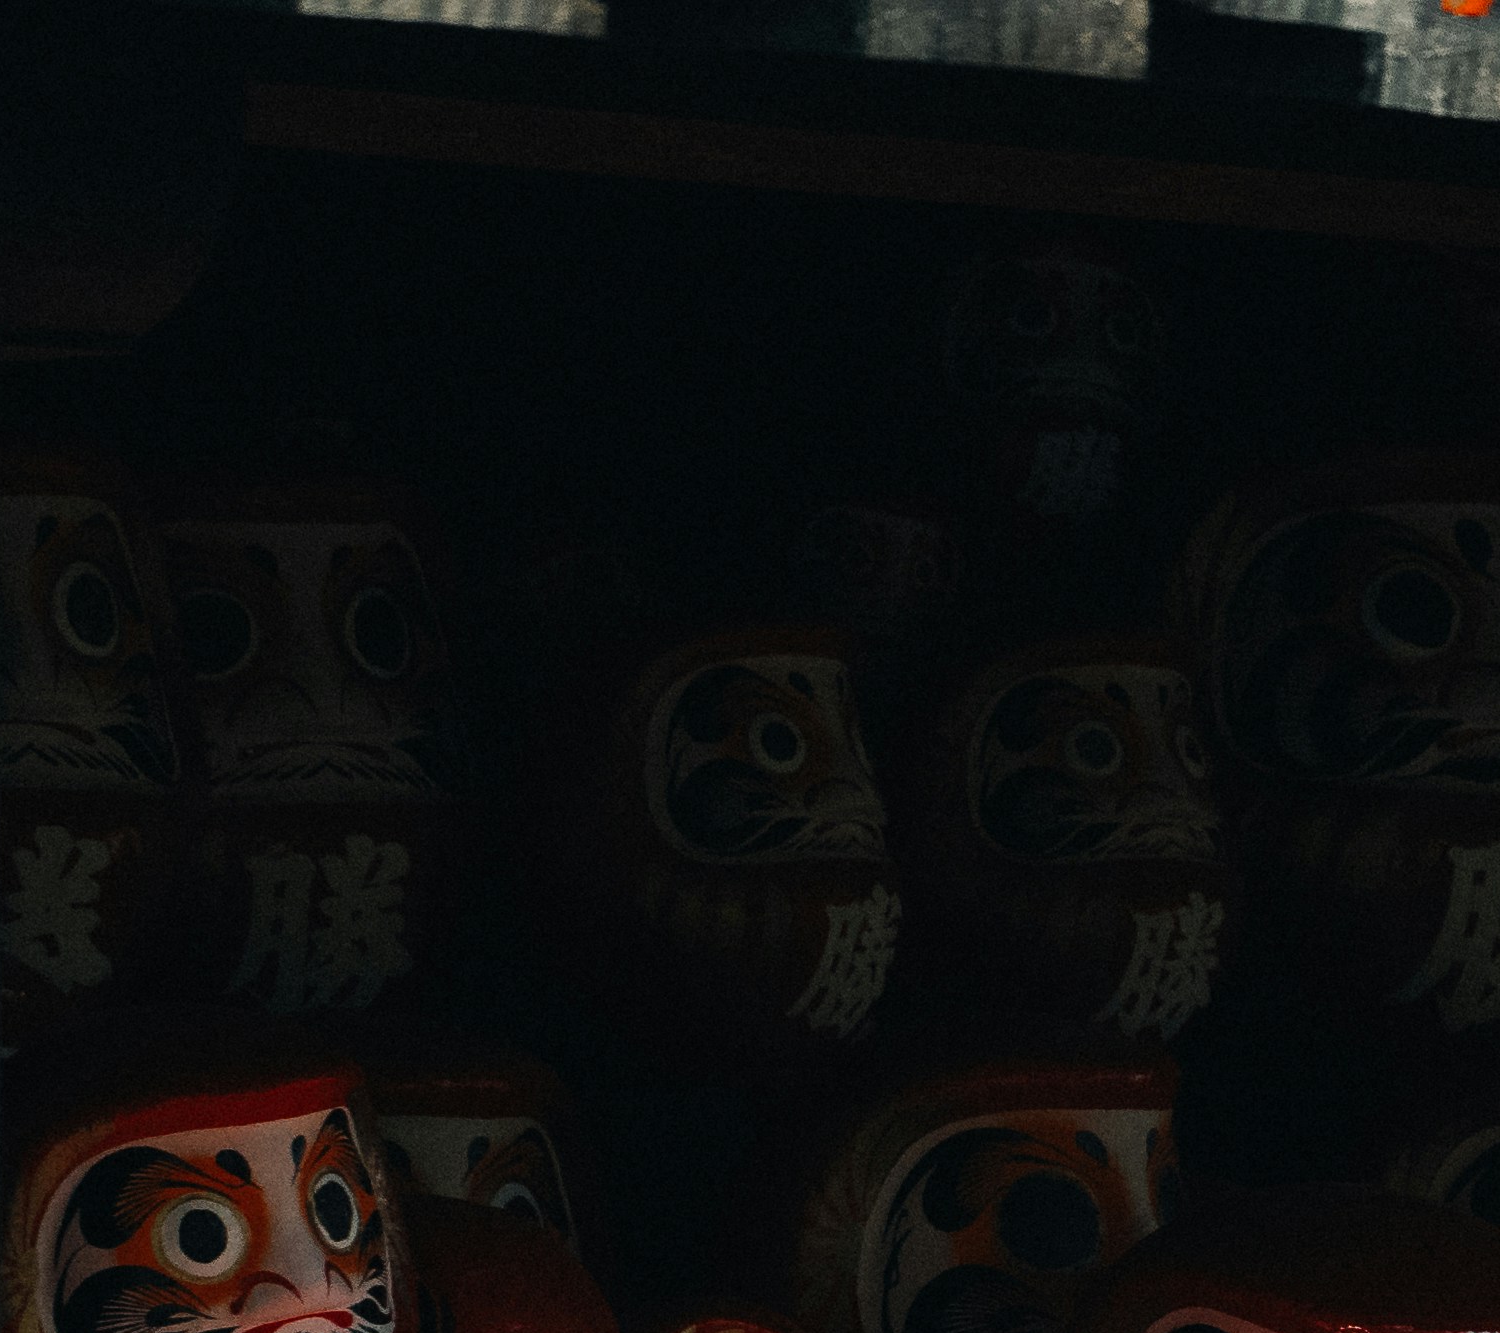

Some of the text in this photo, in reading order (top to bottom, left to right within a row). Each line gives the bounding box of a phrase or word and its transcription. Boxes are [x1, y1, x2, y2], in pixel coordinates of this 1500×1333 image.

[231, 834, 414, 1011] 勝
[789, 884, 900, 1037] 勝
[1097, 892, 1225, 1039] 勝
